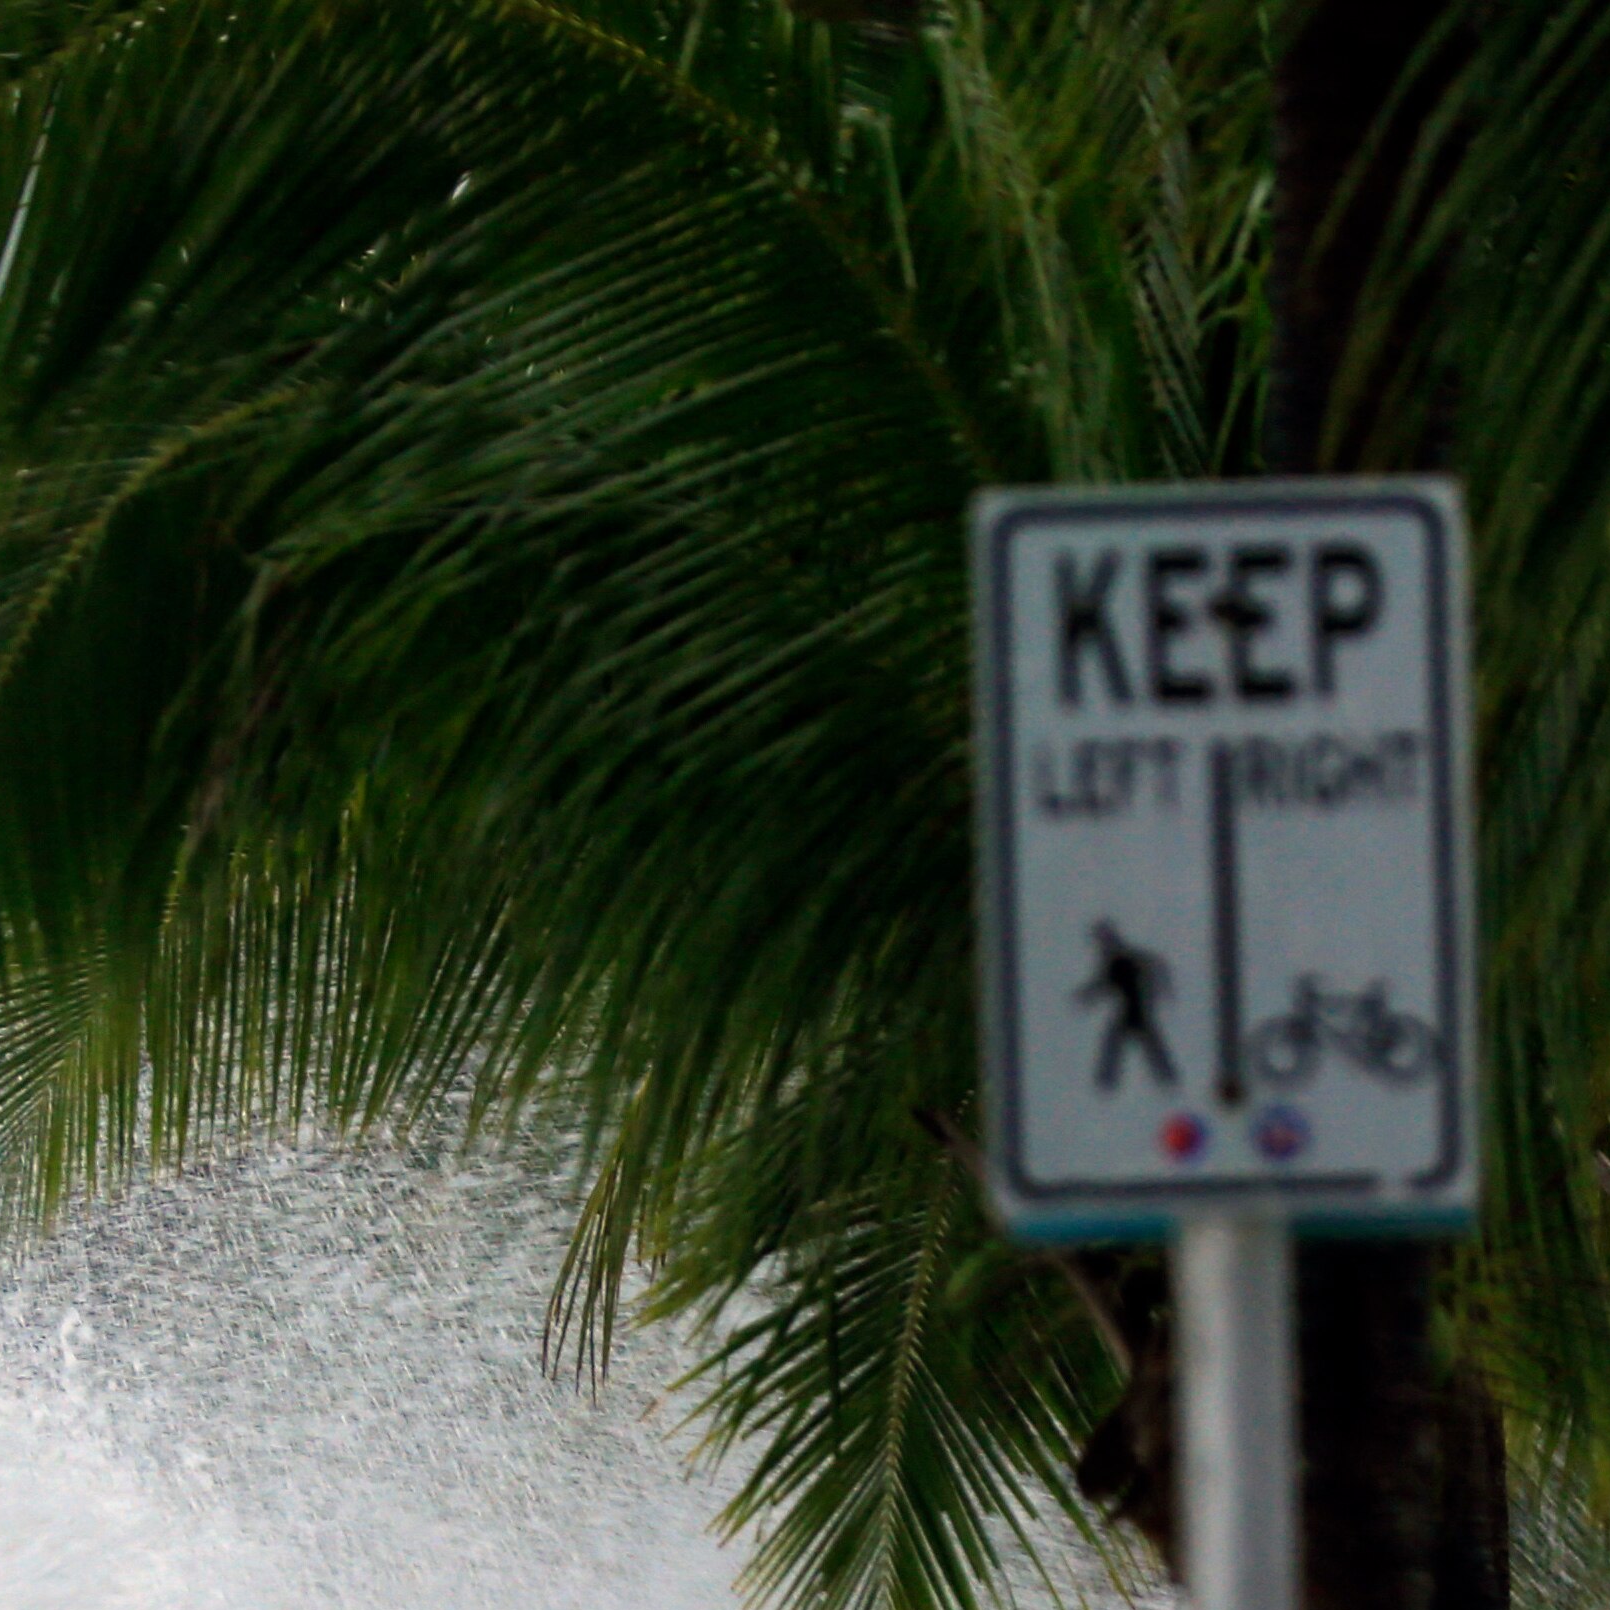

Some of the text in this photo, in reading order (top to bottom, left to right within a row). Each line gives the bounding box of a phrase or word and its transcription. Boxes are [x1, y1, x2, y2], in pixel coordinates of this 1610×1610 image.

[1053, 542, 1383, 707] KEEP
[1031, 731, 1418, 814] LEFT RIGHT
